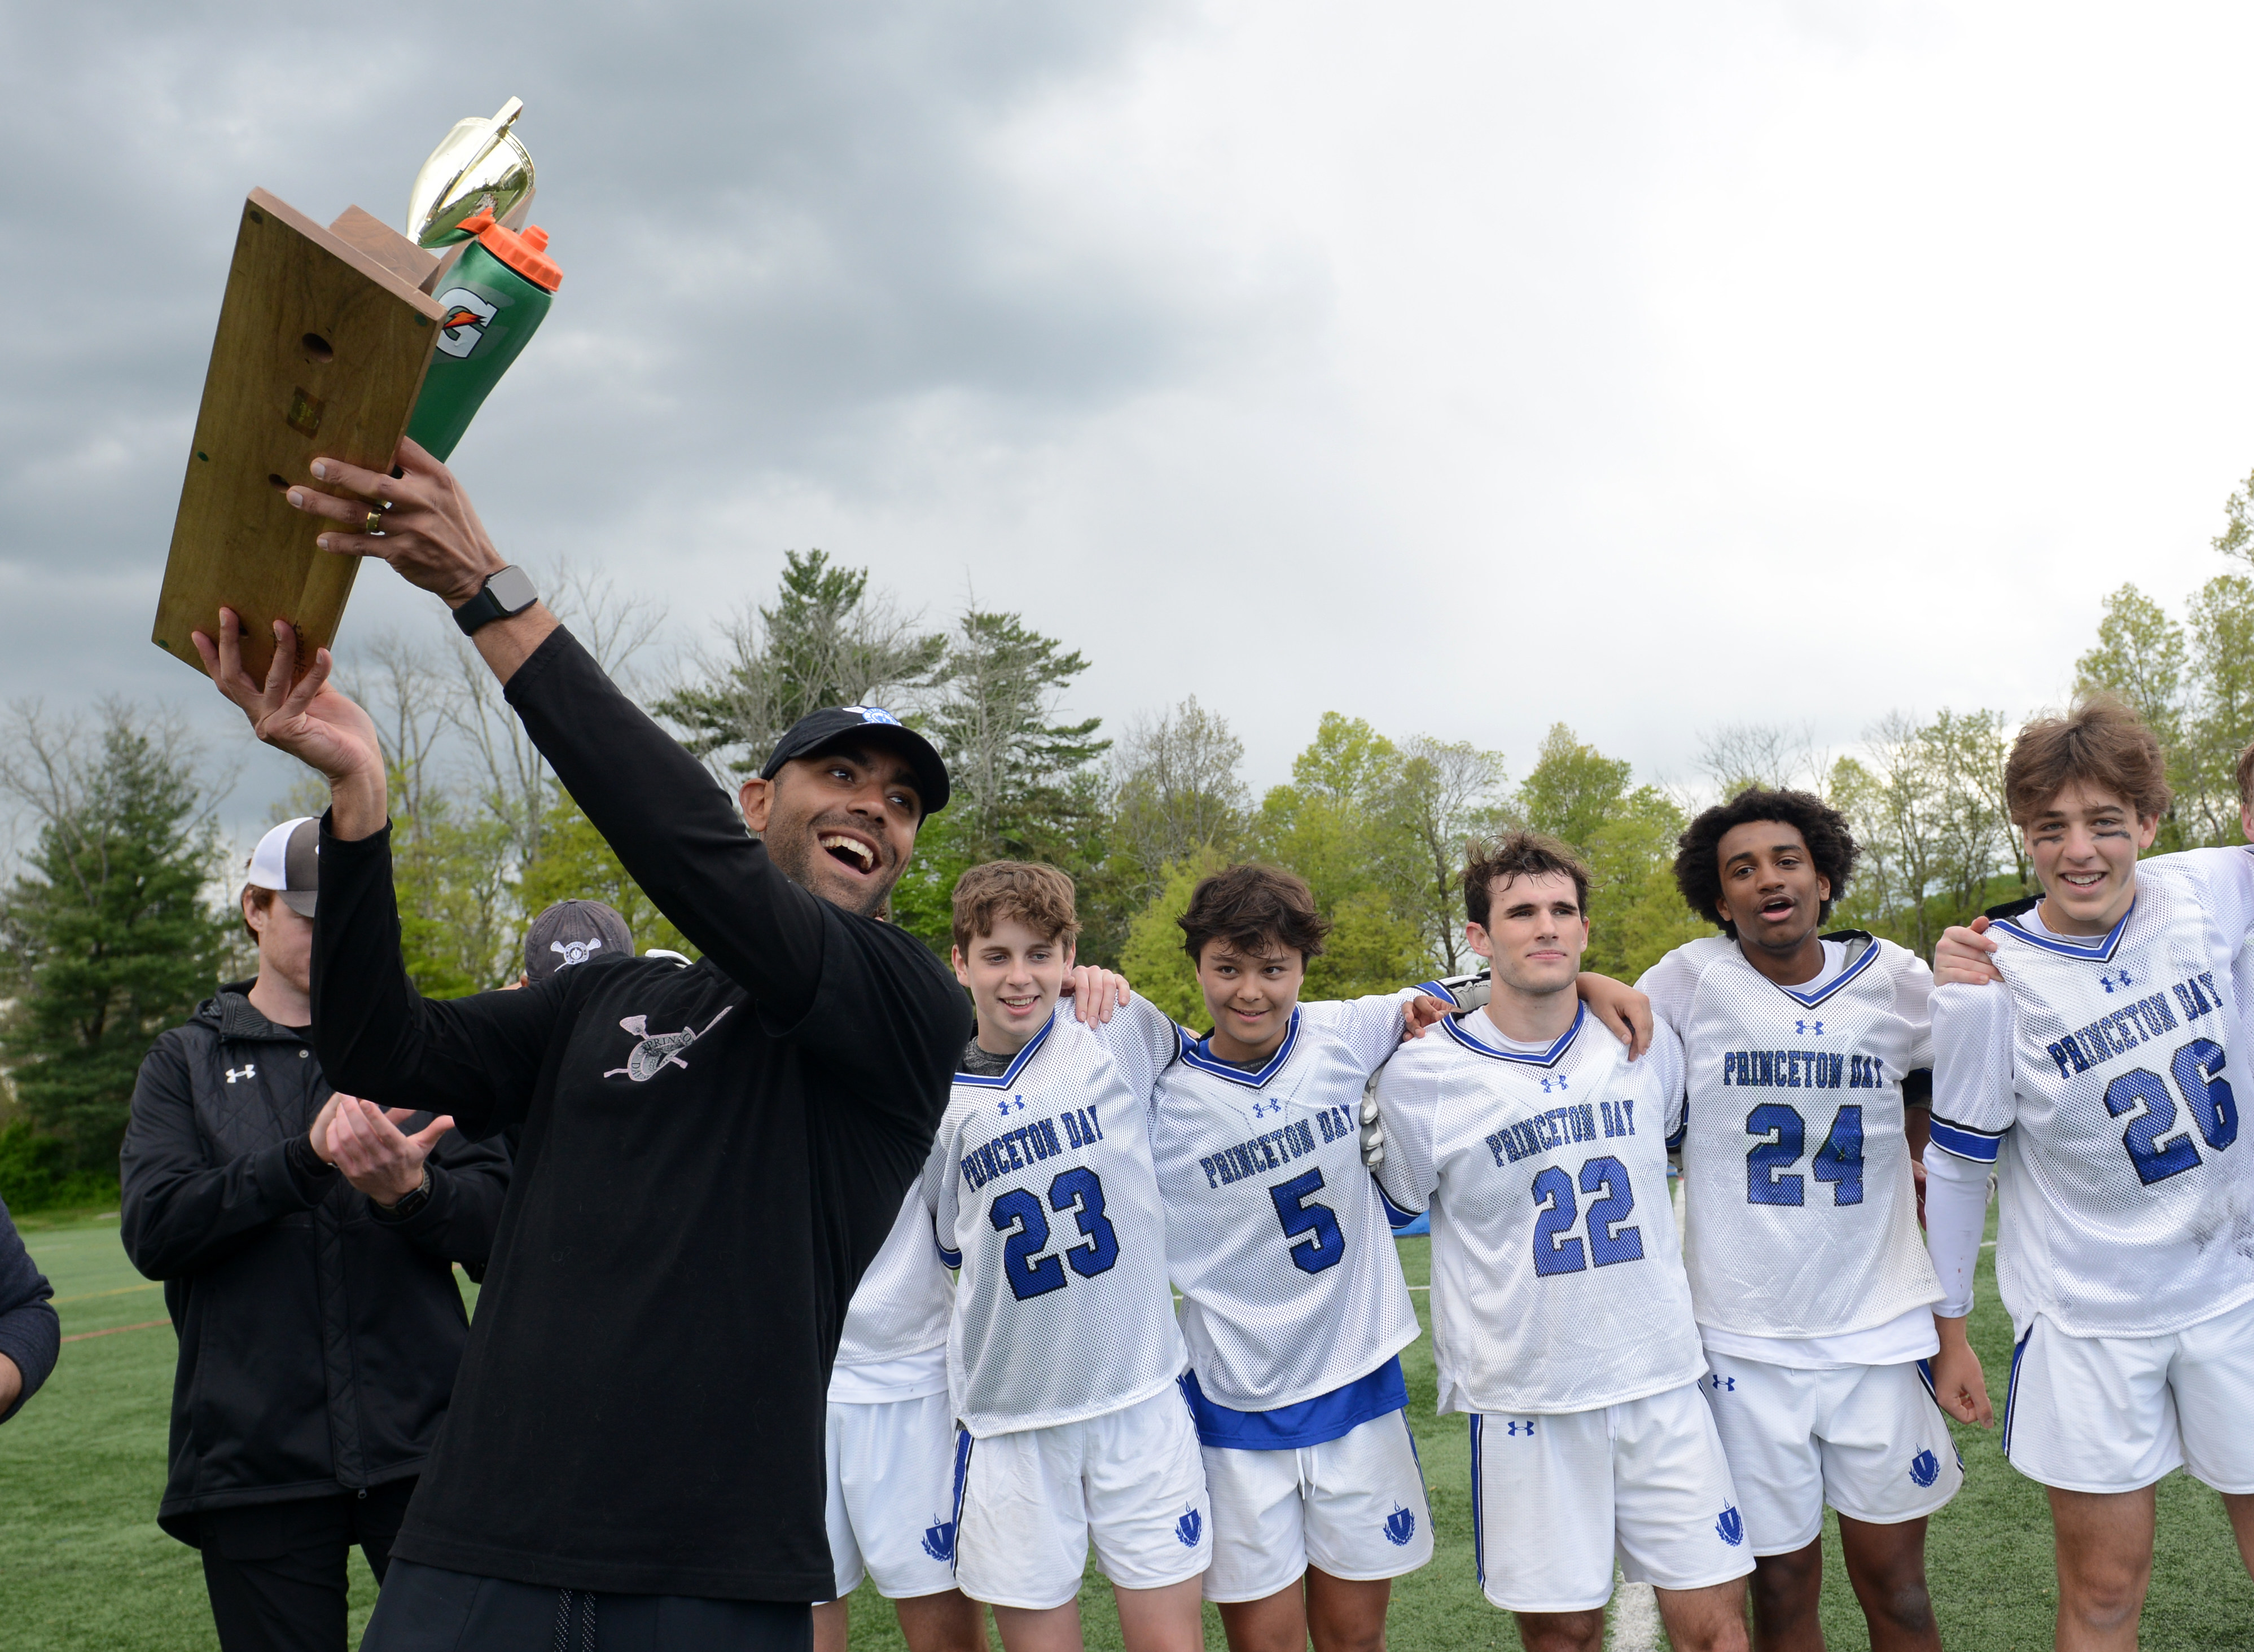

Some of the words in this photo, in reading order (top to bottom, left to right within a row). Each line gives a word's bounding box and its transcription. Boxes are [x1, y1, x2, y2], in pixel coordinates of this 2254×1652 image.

[436, 287, 499, 359] G
[646, 1033, 692, 1049] PRINO
[1724, 1050, 1844, 1088] PRINCETON
[1849, 1055, 1884, 1088] DAY
[2046, 992, 2178, 1079] PRINCETON
[2173, 972, 2224, 1021] DAY
[960, 1118, 1062, 1193] PRINCETON
[1061, 1105, 1103, 1150] DAY
[1199, 1118, 1315, 1189] PRINCETON
[1316, 1104, 1356, 1146] DAY
[1484, 1103, 1597, 1167] PRINCETON
[1601, 1100, 1635, 1137] DAY
[1746, 1103, 1864, 1206] 24
[2103, 1037, 2239, 1187] 26
[989, 1166, 1119, 1301] 23
[1269, 1166, 1345, 1275] 5
[1531, 1155, 1645, 1277] 22
